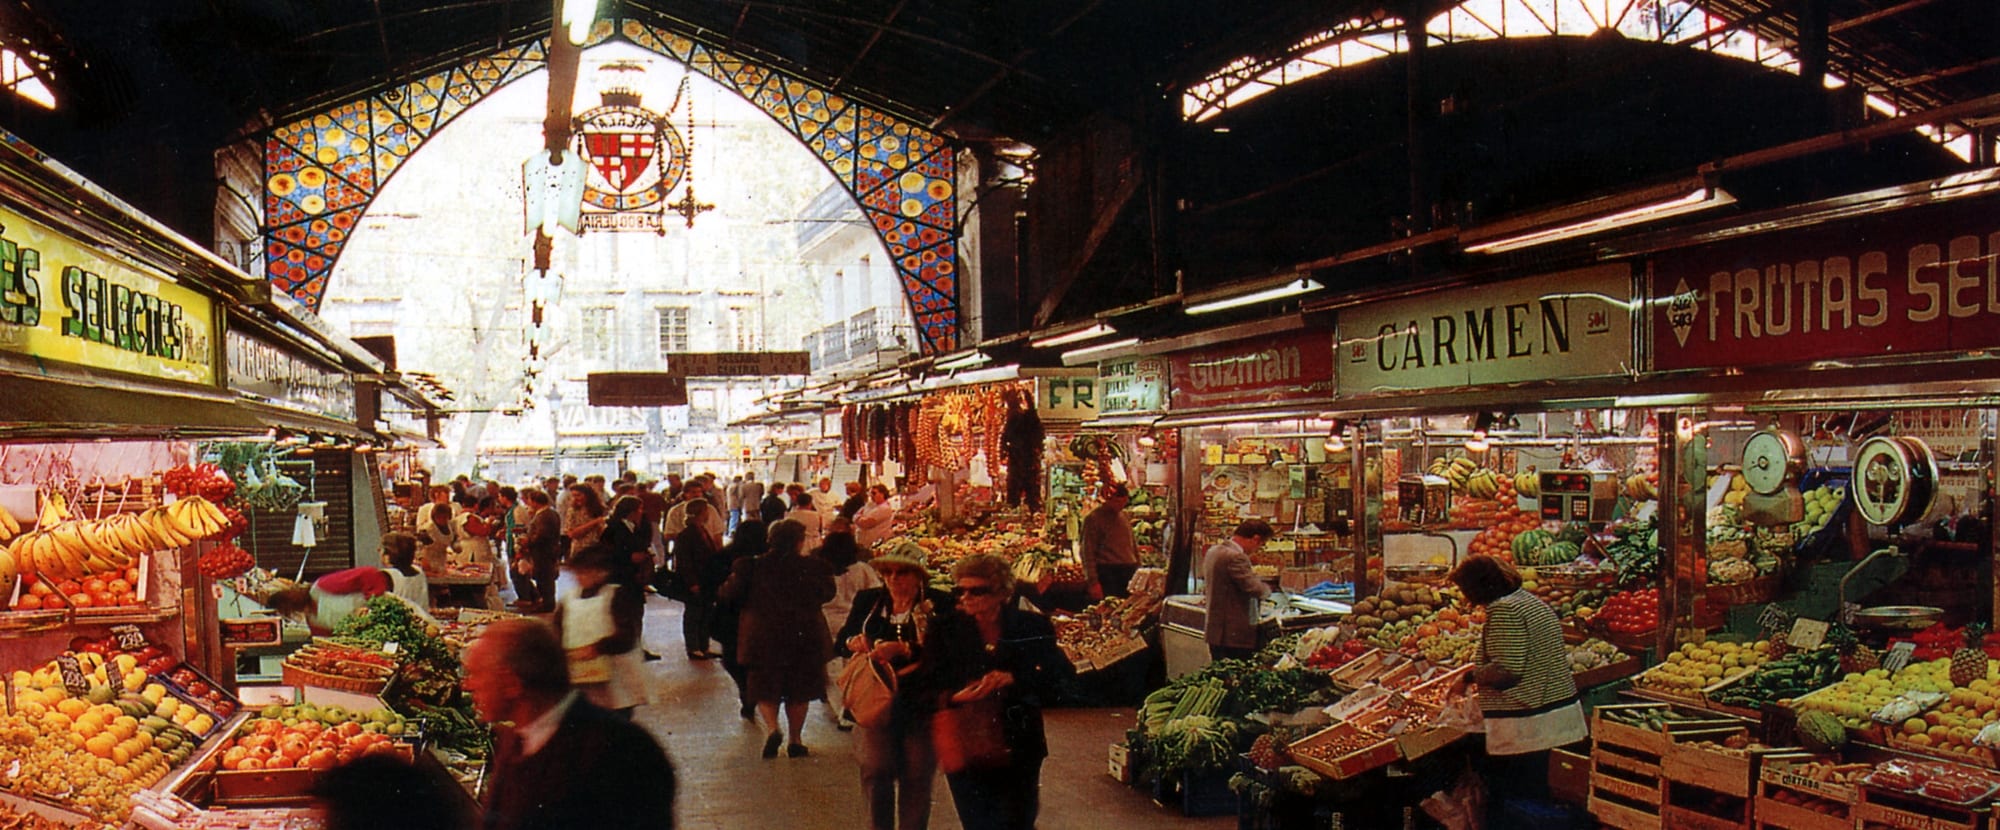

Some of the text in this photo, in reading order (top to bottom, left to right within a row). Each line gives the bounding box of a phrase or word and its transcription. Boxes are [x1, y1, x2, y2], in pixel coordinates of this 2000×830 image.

[61, 265, 183, 361] SELECTES
[1377, 296, 1571, 371] CARMEN
[1709, 251, 1888, 342] FRUTAS
[1049, 376, 1095, 410] FR
